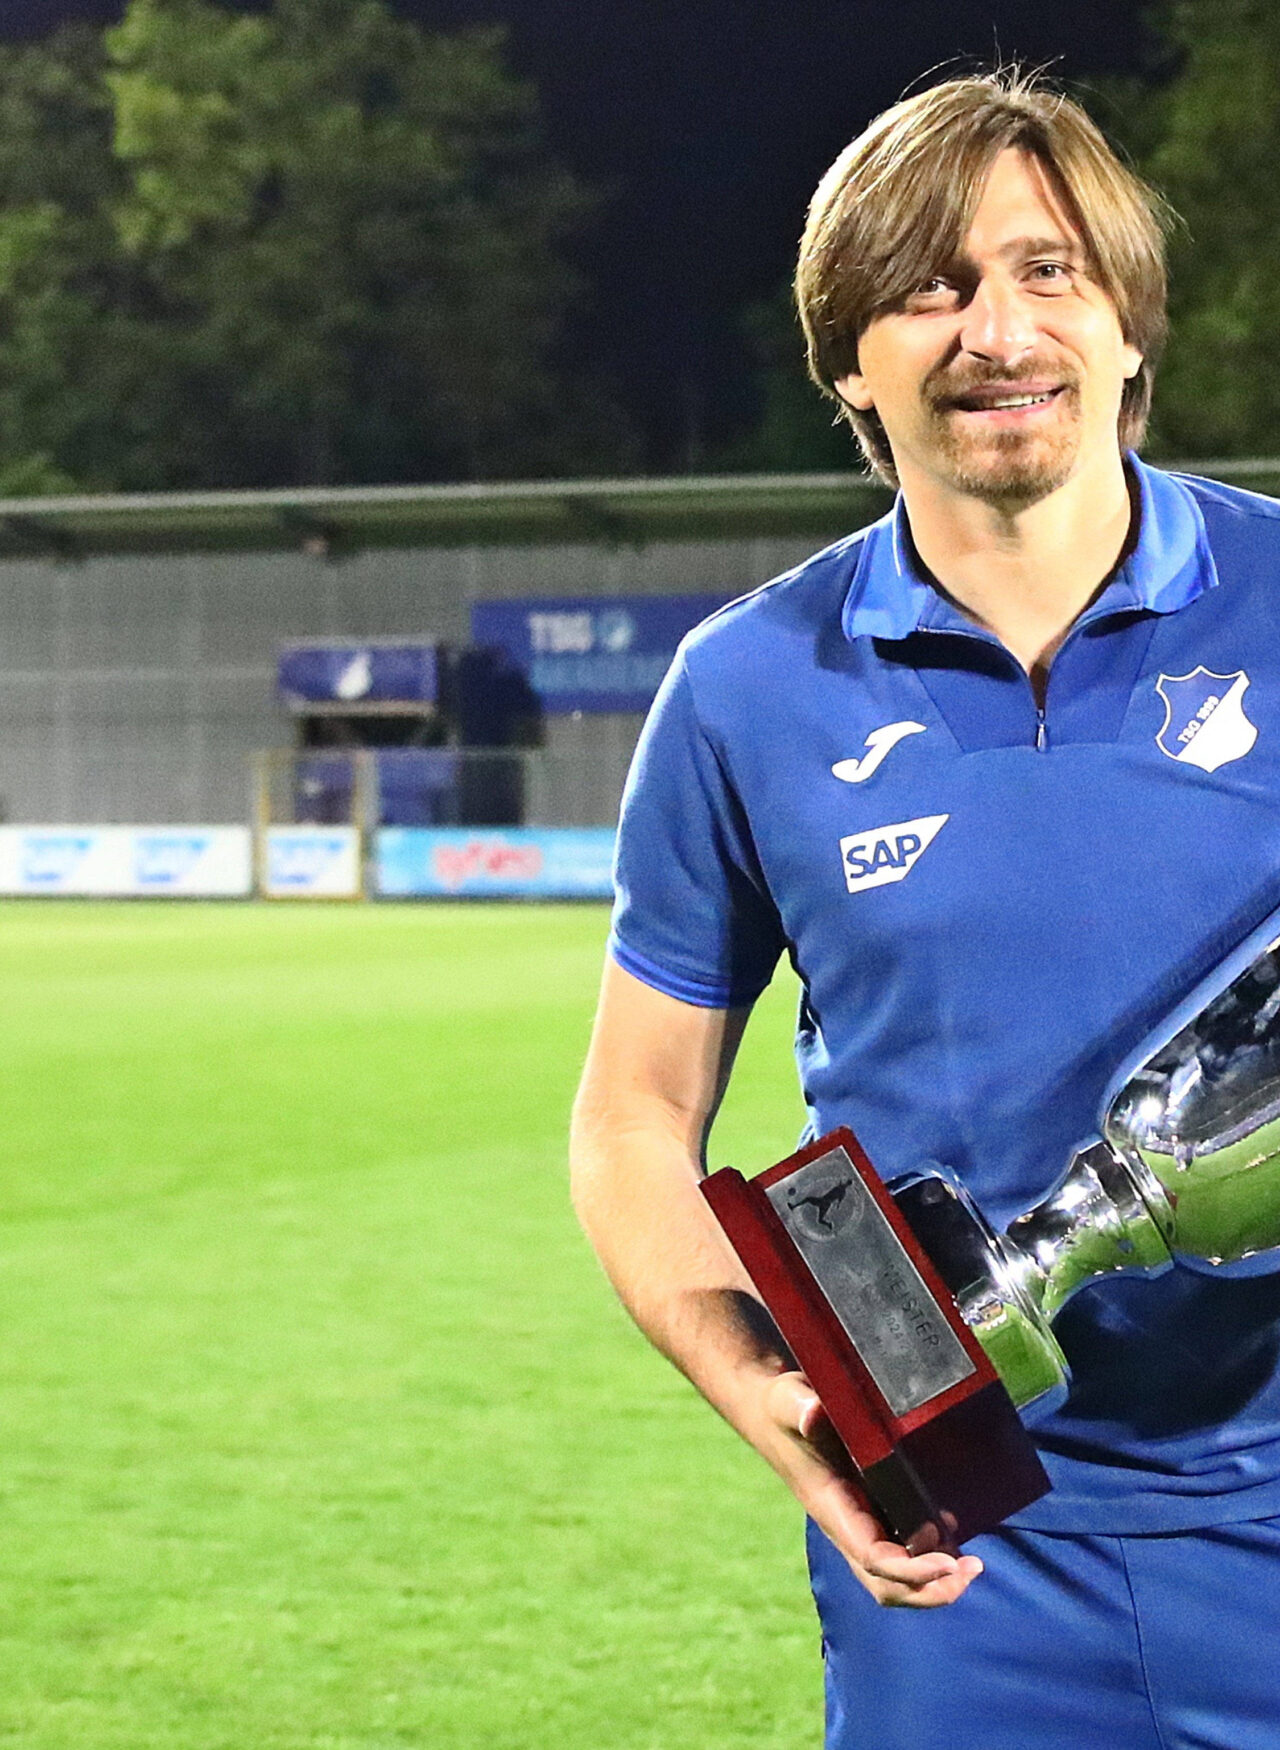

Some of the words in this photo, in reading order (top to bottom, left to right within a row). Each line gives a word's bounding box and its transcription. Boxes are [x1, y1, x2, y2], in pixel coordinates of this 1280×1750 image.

[1176, 719, 1201, 744] TSG
[846, 833, 922, 879] SAP
[880, 1261, 940, 1347] MEISTER
